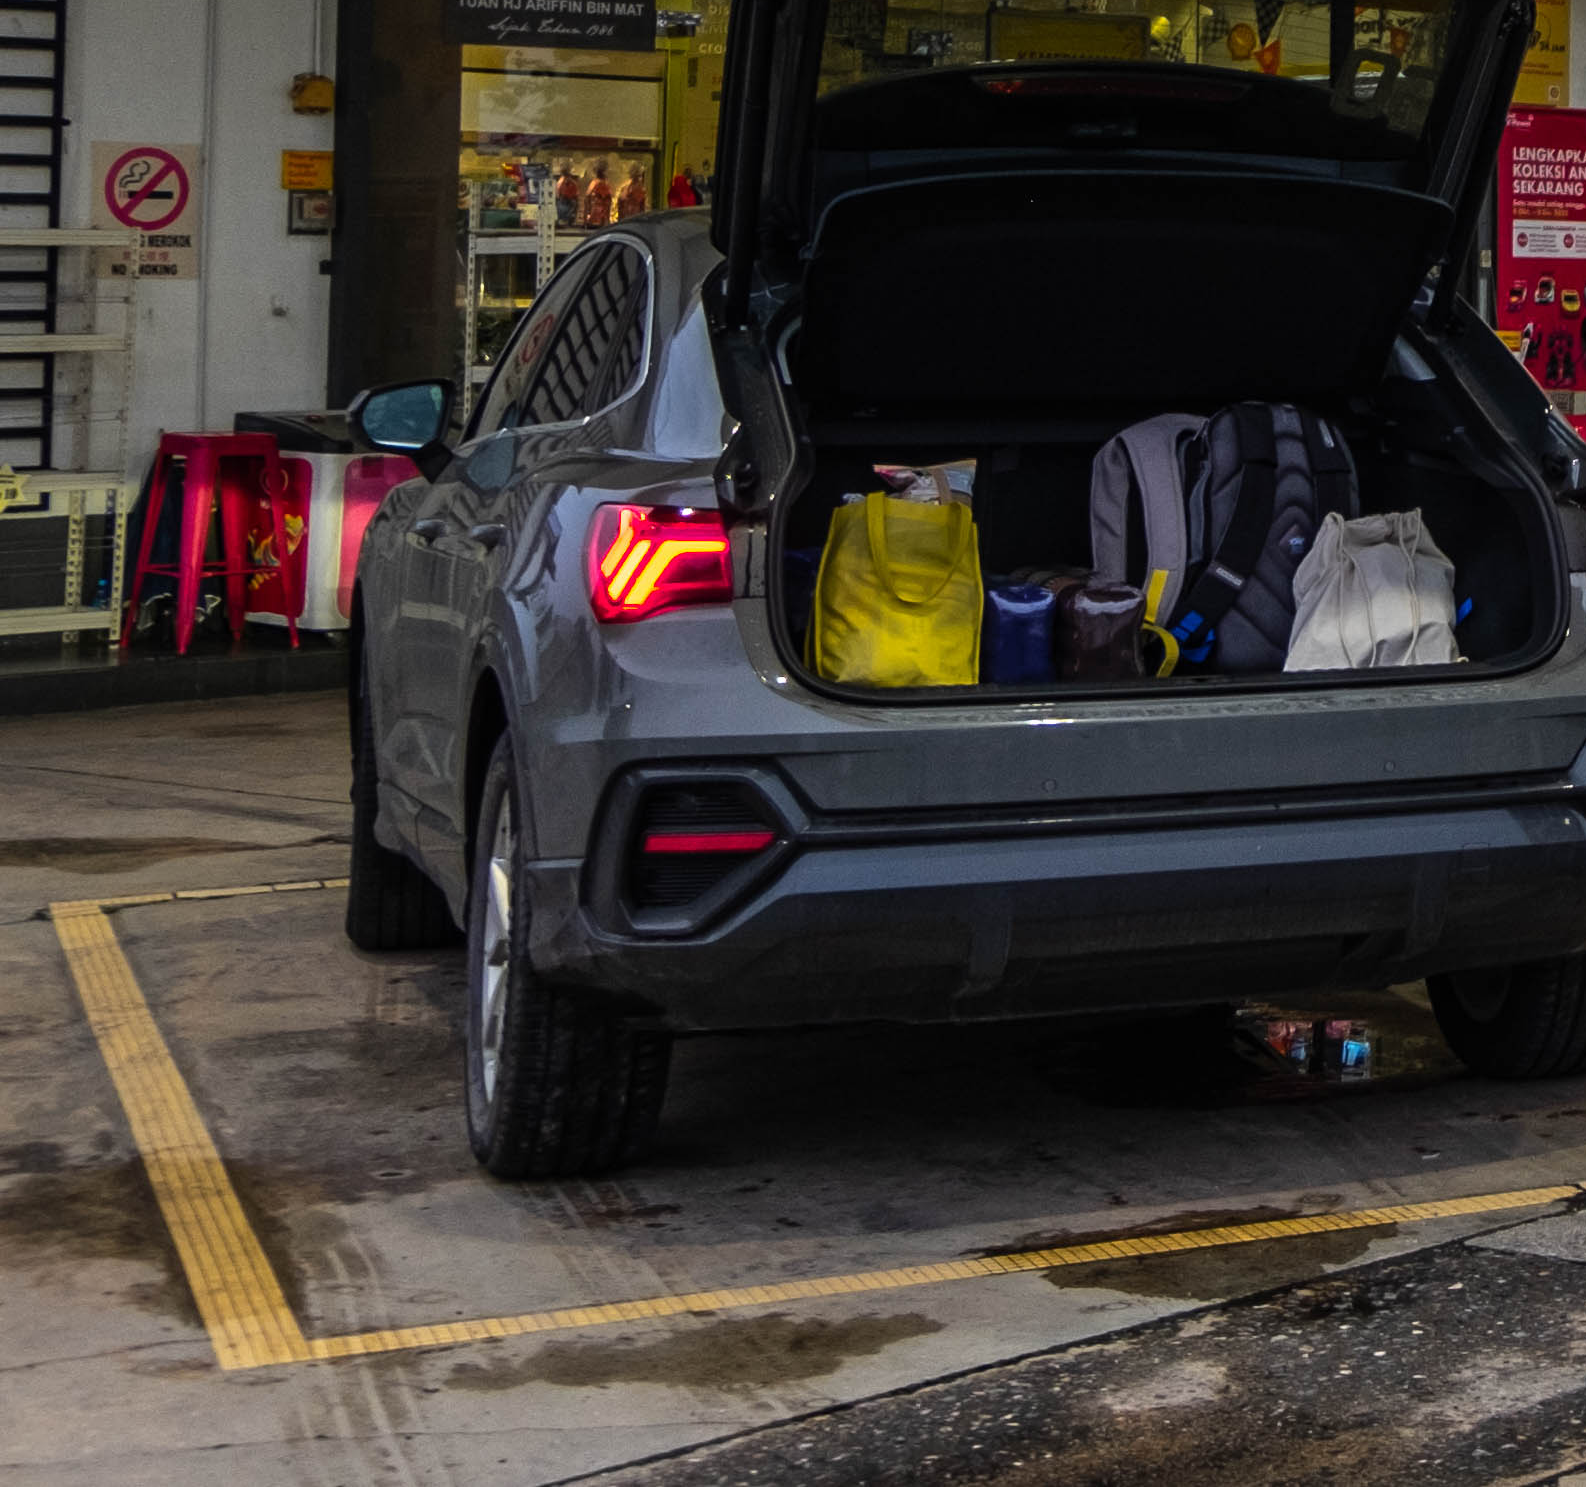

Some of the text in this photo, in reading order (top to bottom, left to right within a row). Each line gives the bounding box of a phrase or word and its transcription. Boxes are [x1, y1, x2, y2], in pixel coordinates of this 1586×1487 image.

[586, 0, 610, 14] BIN
[614, 2, 645, 16] MAT
[1513, 163, 1565, 179] KOLEKSI
[1513, 180, 1584, 197] SEKARANG
[112, 264, 177, 275] NO MOKING
